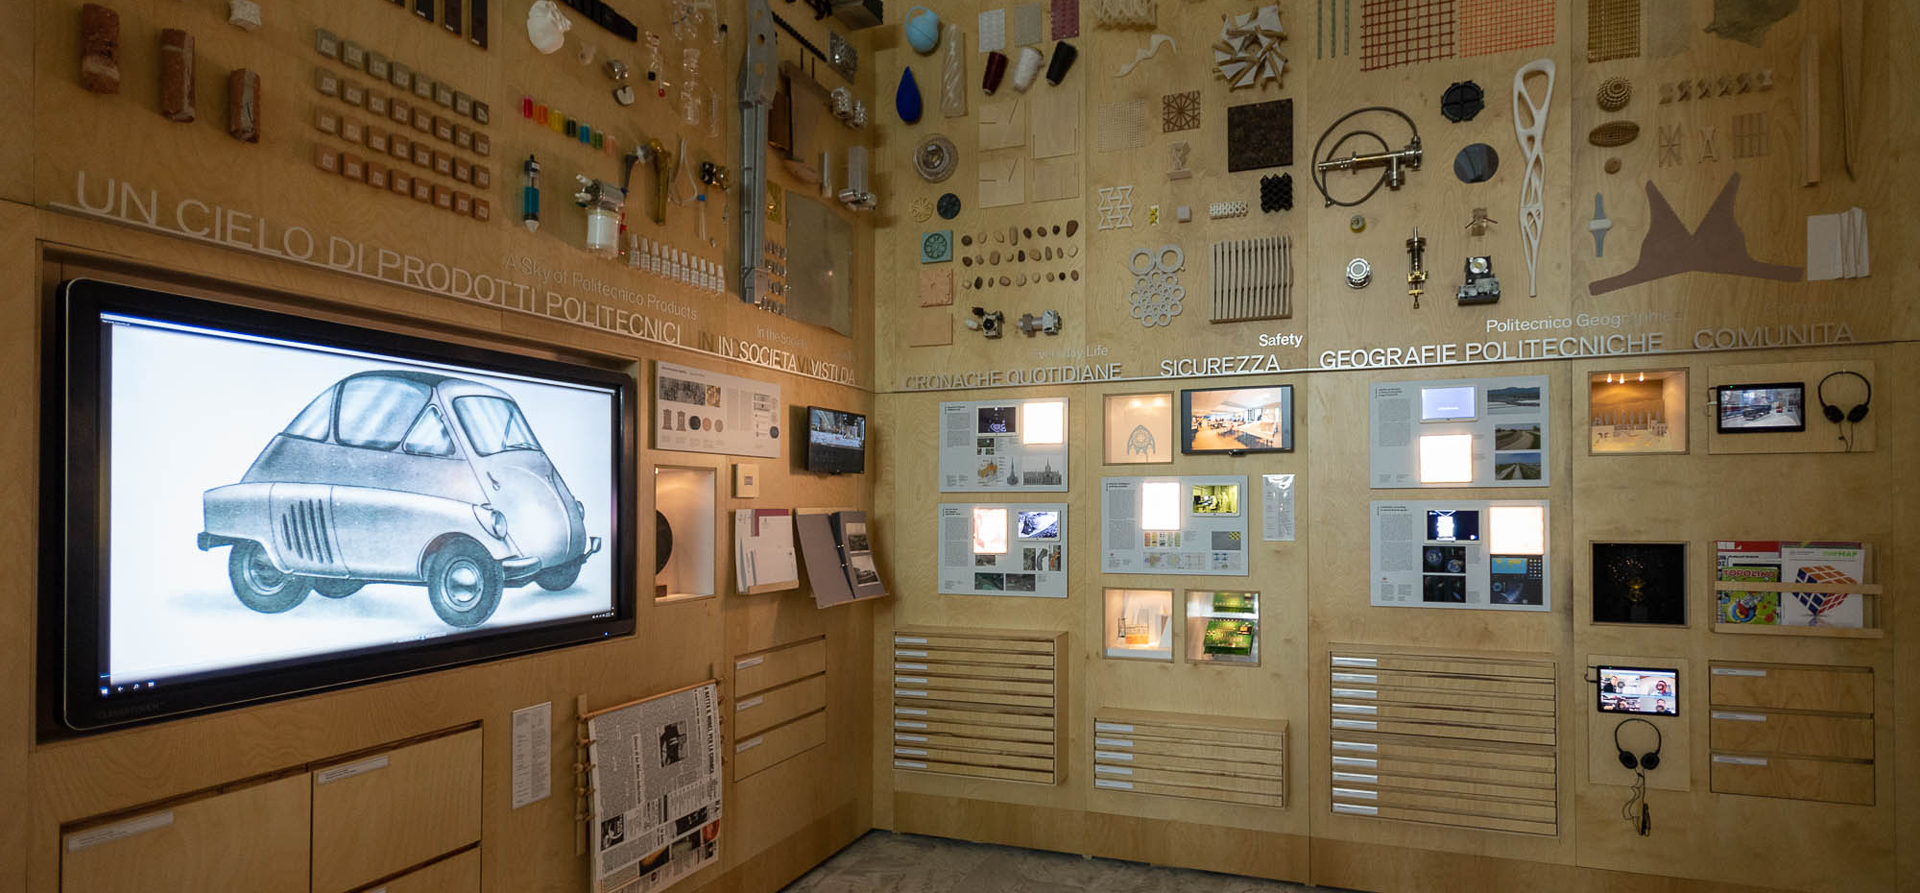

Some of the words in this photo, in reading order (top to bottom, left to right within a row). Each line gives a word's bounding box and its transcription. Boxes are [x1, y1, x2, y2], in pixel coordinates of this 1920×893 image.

[77, 170, 158, 227] UN
[176, 199, 315, 261] CIELO
[329, 236, 364, 273] DI
[378, 248, 536, 314] PRODOTTI
[547, 291, 681, 346] POLITECNICI
[505, 255, 518, 272] A
[520, 256, 550, 284] Sky
[553, 269, 569, 285] of
[573, 271, 644, 306] Politecnico
[647, 293, 698, 321] Products
[756, 324, 765, 338] In
[1486, 316, 1573, 333] Politecnico
[1694, 322, 1854, 350] COMUNITA
[718, 335, 733, 359] IN
[739, 341, 797, 372] SOCIETA
[1086, 344, 1109, 357] Life
[1258, 332, 1303, 348] Safety
[1320, 344, 1459, 369] GEOGRAFIE
[1465, 332, 1665, 361] POLITECNICHE
[811, 359, 839, 382] VISTI
[840, 366, 856, 386] DA
[905, 370, 1003, 390] CRONACHE
[1006, 363, 1122, 386] QUOTIDIANE
[1160, 354, 1282, 377] SICUREZZA
[1722, 569, 1775, 578] TOPOLINO
